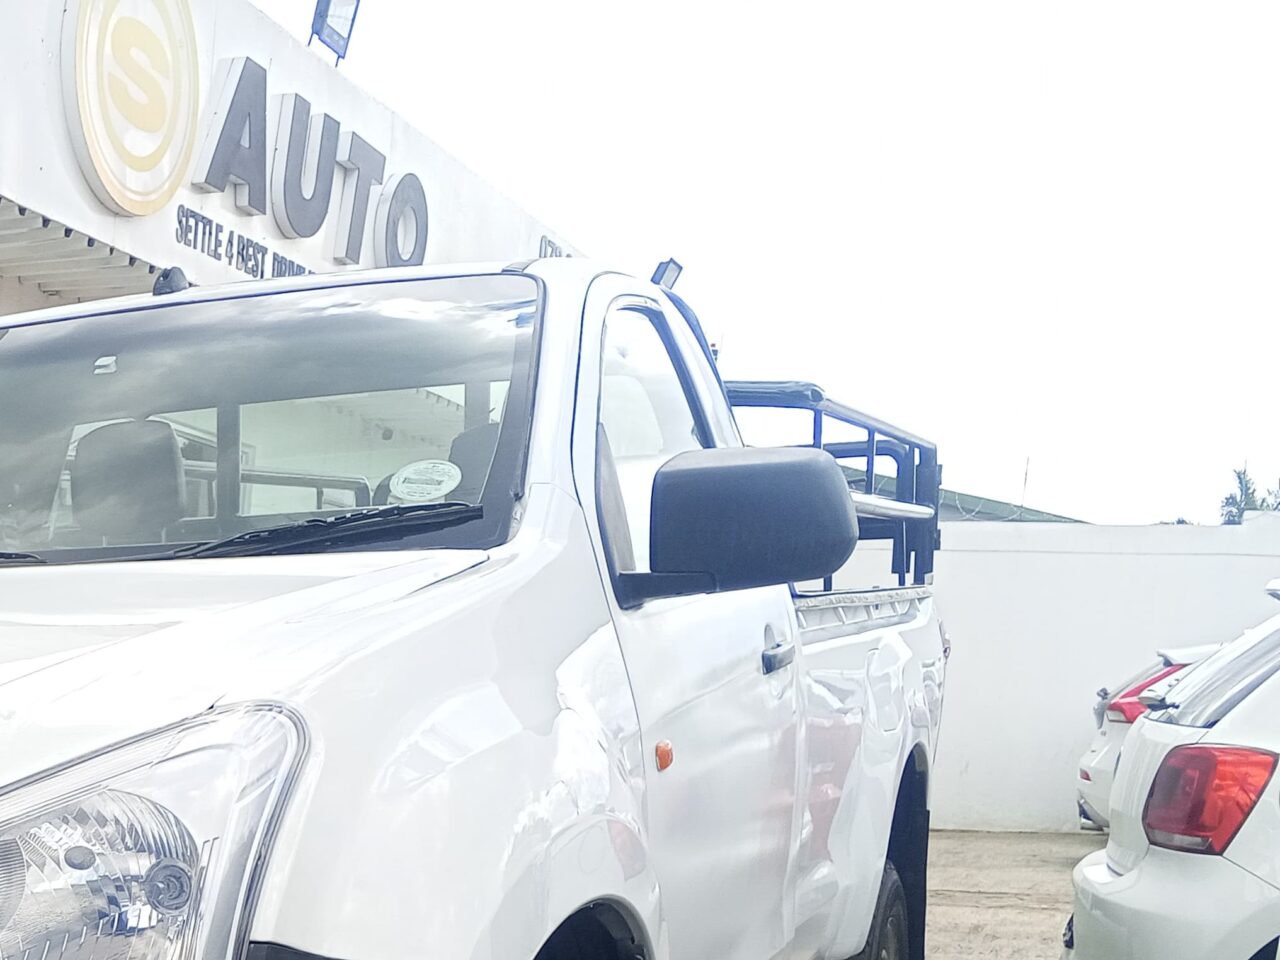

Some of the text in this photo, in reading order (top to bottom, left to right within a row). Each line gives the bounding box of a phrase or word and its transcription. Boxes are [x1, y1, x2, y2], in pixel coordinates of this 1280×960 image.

[108, 16, 428, 267] S AUTO
[176, 204, 223, 260] SETTLE
[225, 230, 234, 266] 4
[236, 234, 268, 280] BEST
